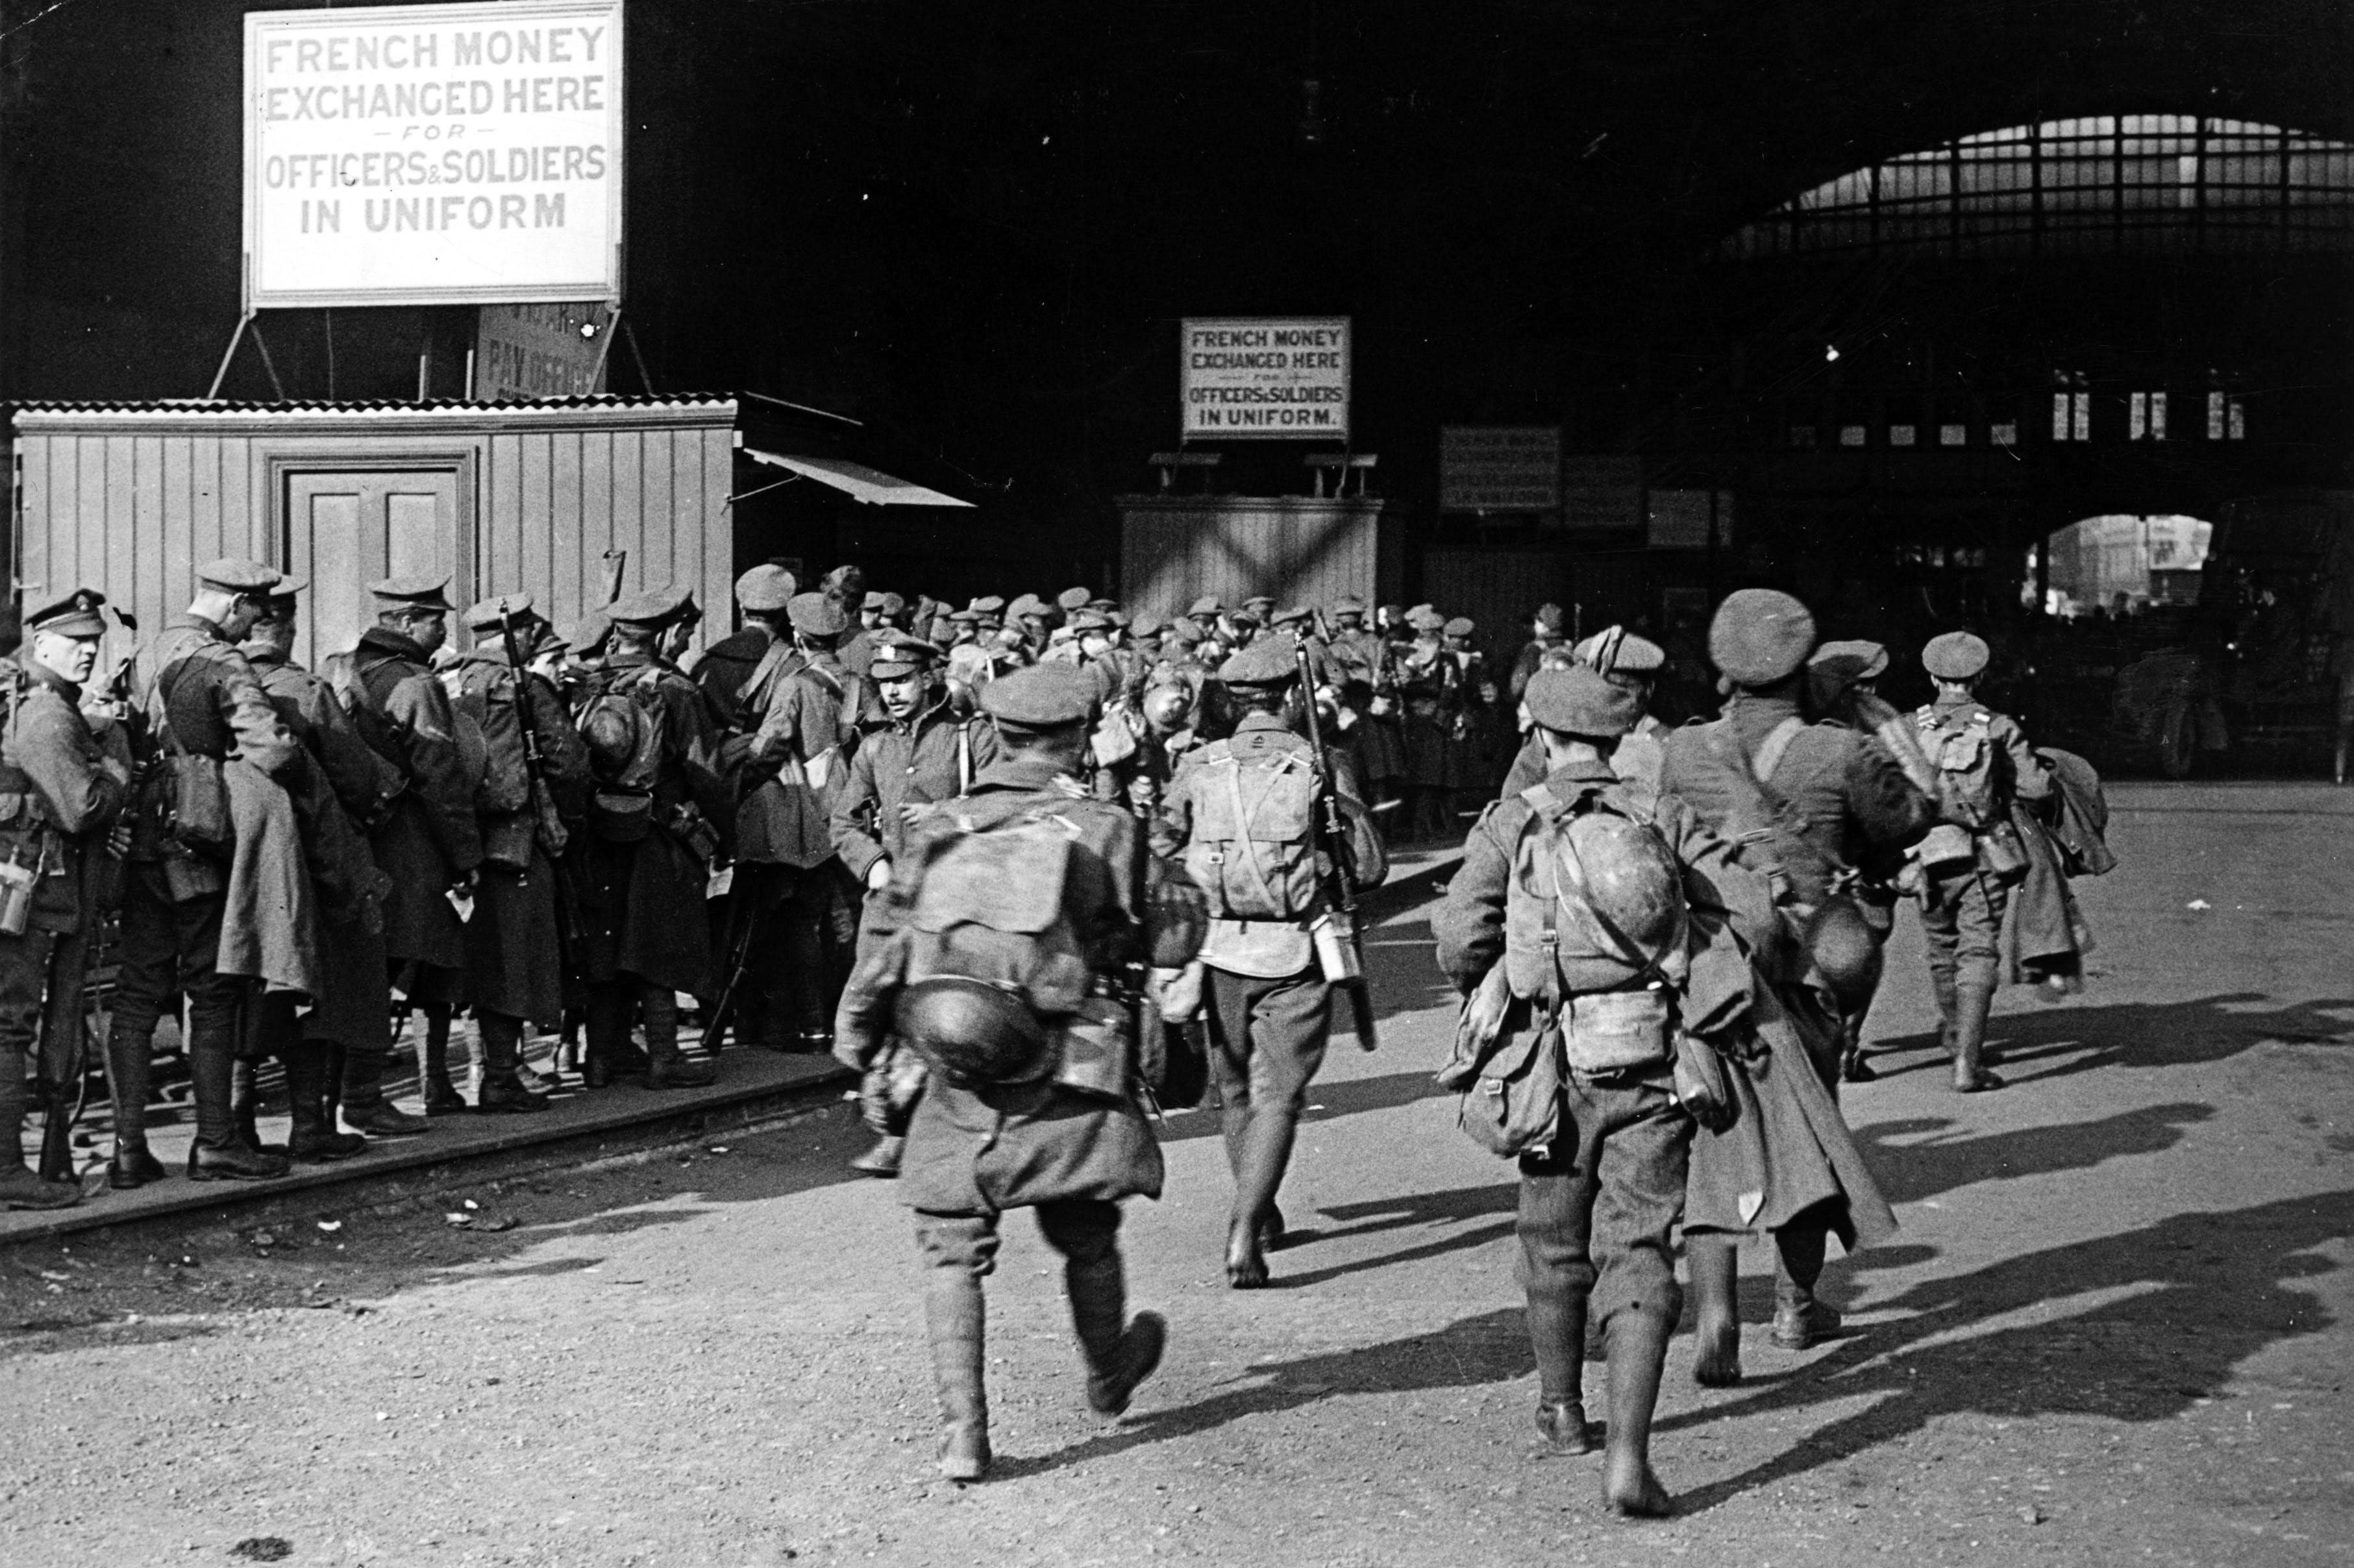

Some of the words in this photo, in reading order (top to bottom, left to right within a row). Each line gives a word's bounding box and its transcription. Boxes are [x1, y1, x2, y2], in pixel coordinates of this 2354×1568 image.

[267, 33, 438, 73] FRENCH
[454, 25, 604, 66] MONEY
[266, 80, 493, 121] EXCHANGED
[503, 75, 604, 113] HERE
[301, 199, 340, 234] IN
[365, 193, 565, 232] UNIFORM
[1192, 330, 1267, 347] FRENCH
[1274, 330, 1340, 346] MONEY
[1191, 352, 1287, 369] EXCHANGED
[1293, 352, 1340, 368] HERE
[1200, 410, 1220, 424] IN
